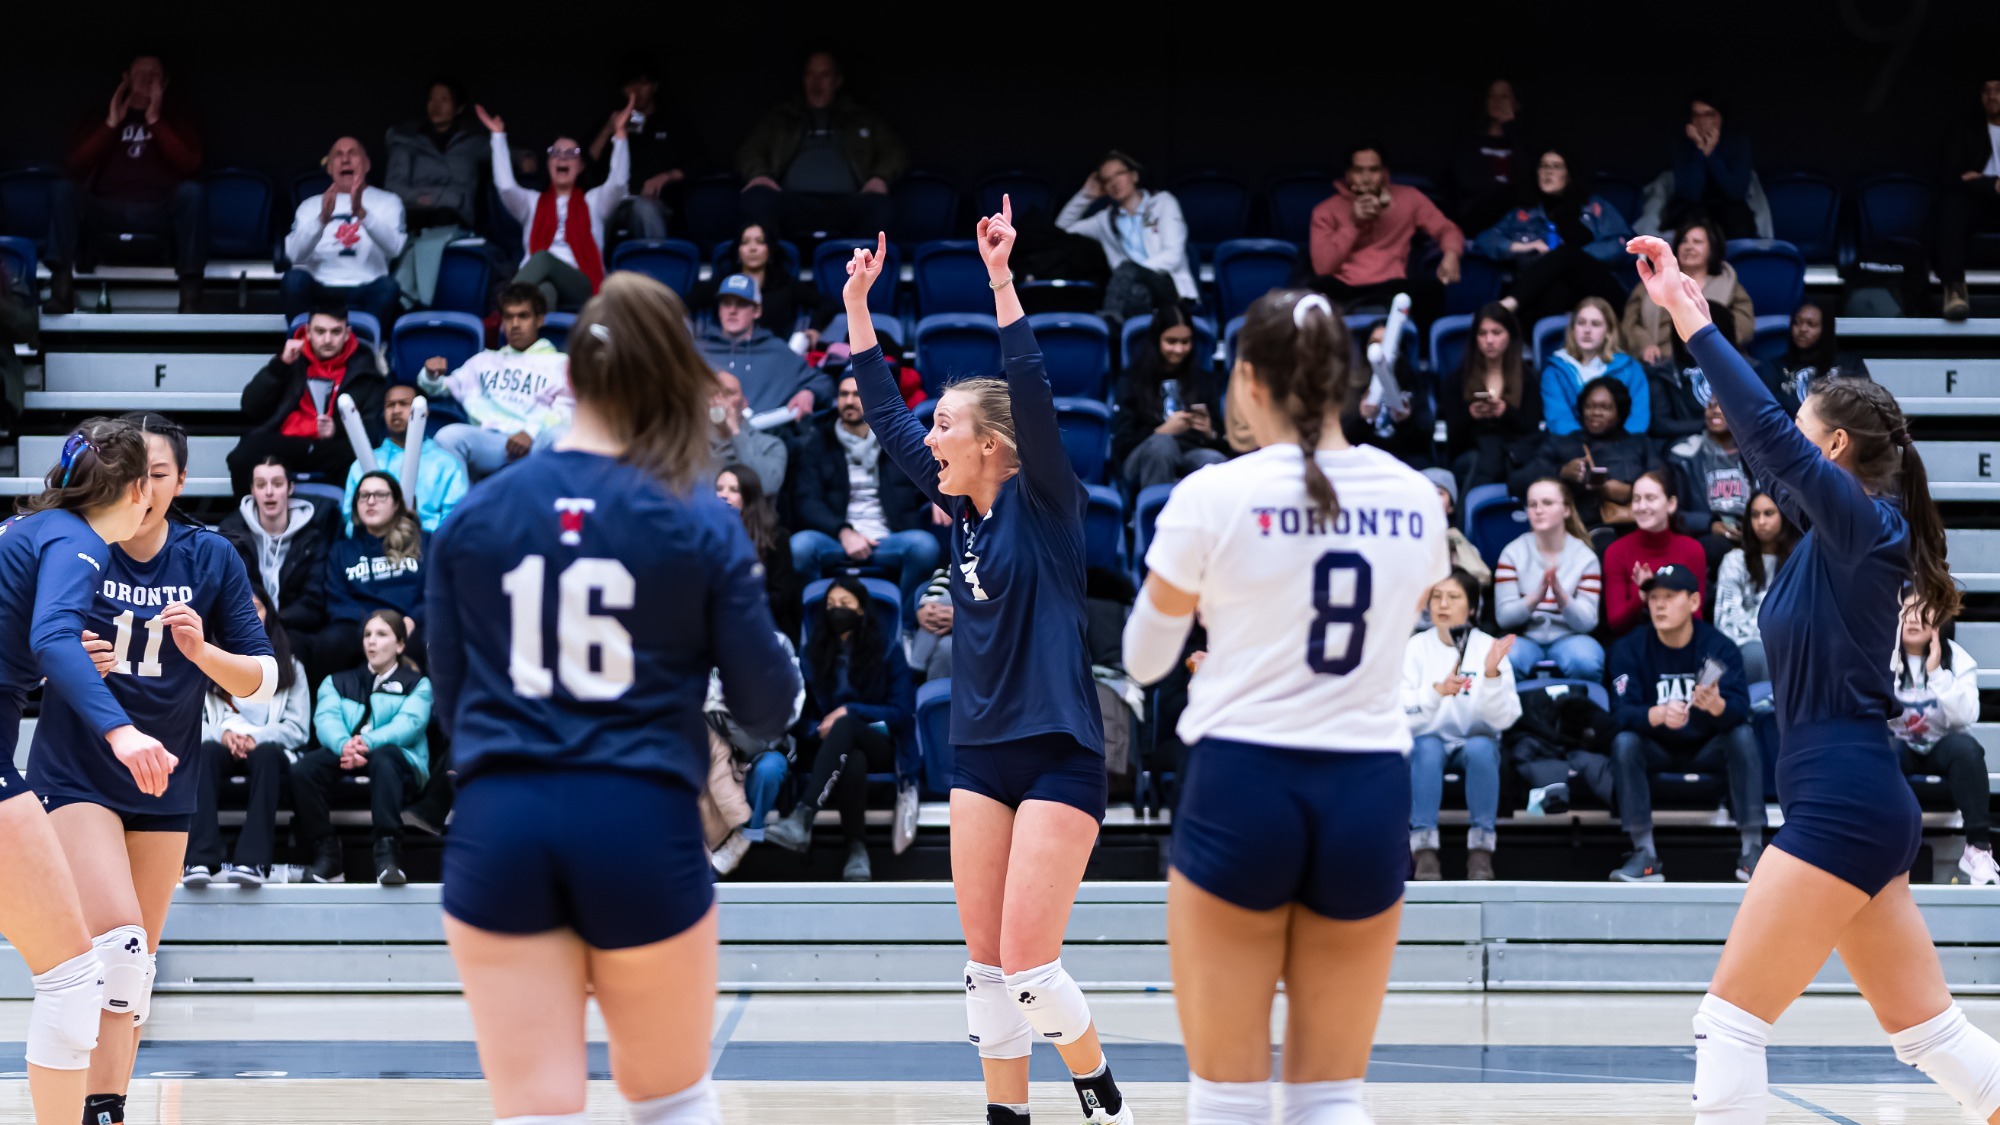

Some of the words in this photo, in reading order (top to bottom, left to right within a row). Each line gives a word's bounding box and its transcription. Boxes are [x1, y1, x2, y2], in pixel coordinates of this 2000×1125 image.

[155, 364, 167, 388] F
[1945, 369, 1958, 394] F
[1978, 453, 1992, 477] E
[1251, 506, 1424, 540] TORONTO
[96, 579, 193, 607] ORONTO
[501, 554, 636, 701] 16
[1306, 550, 1373, 677] 8
[109, 609, 164, 677] 11
